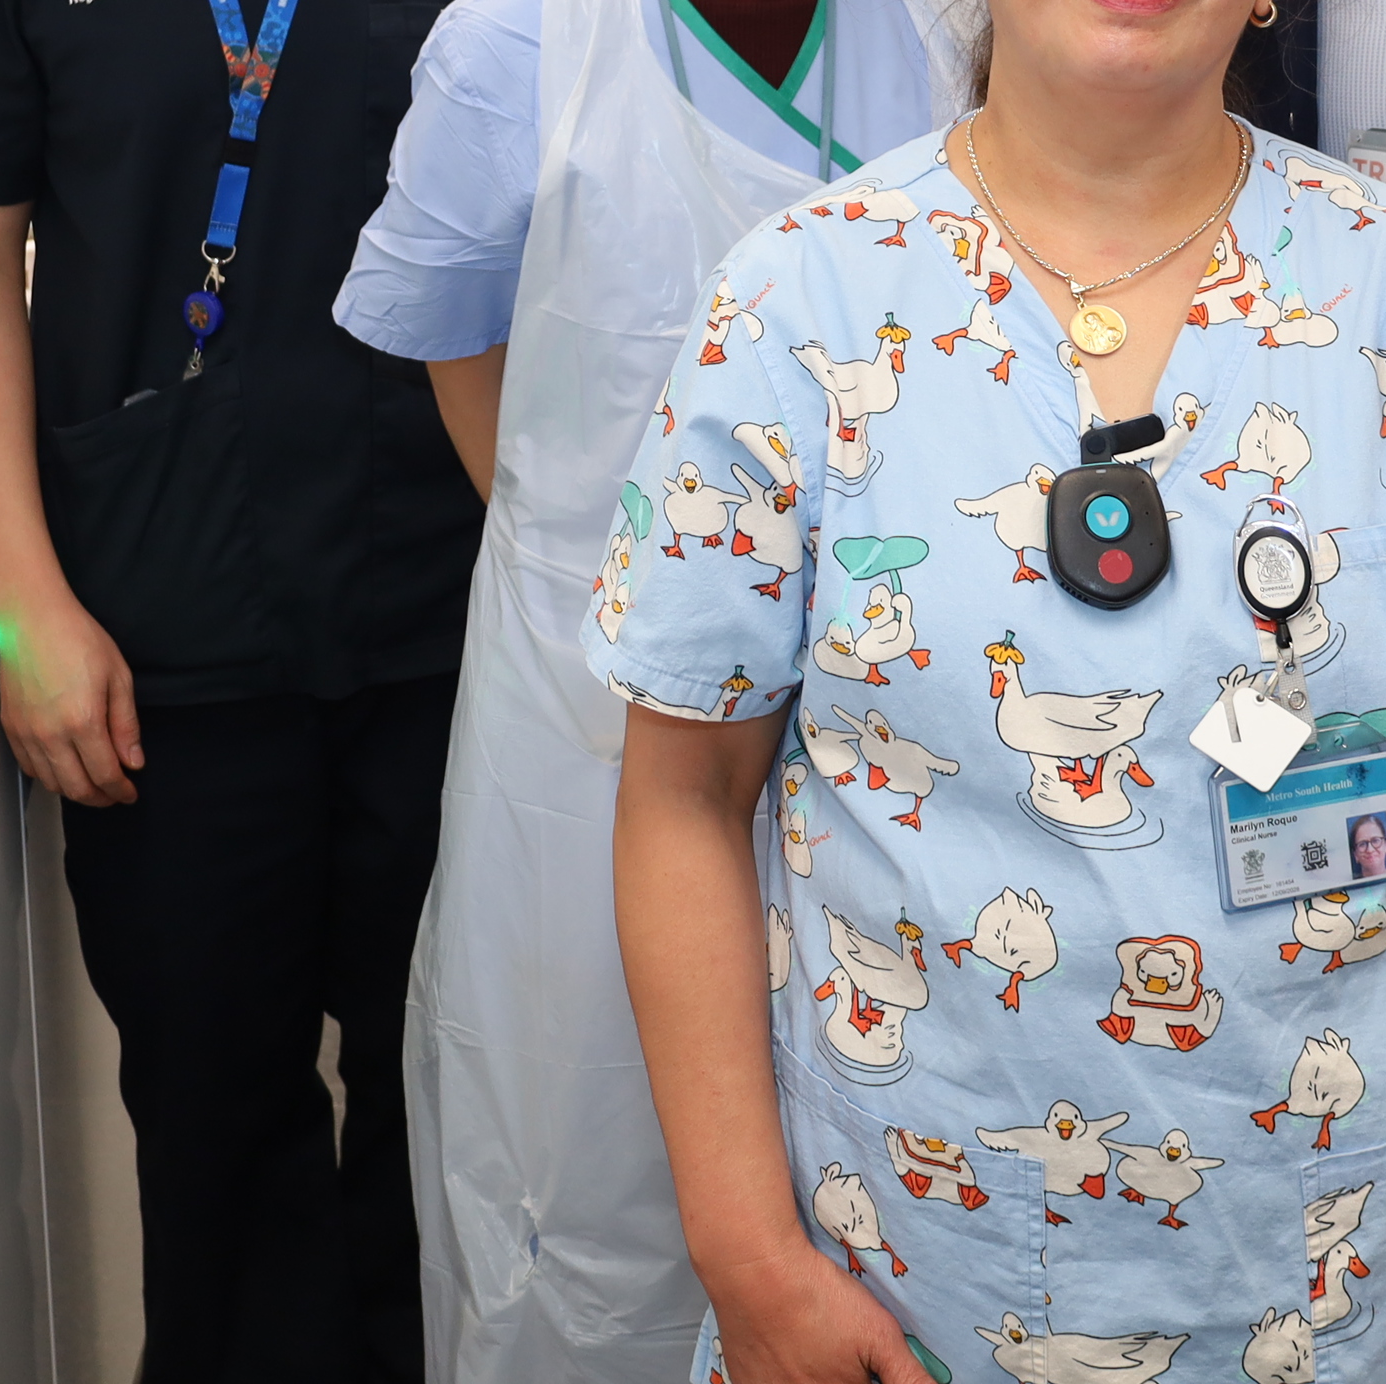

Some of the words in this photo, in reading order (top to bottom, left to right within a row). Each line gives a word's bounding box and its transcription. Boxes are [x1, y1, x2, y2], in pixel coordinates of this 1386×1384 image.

[1260, 583, 1294, 592] Queensland
[1265, 791, 1293, 804] Metro
[1294, 785, 1322, 798] South
[1323, 779, 1353, 792] Health
[1230, 821, 1265, 835] Marilyn
[1267, 815, 1298, 829] Roque
[1231, 834, 1256, 845] Clinical
[1258, 831, 1278, 840] Nurse
